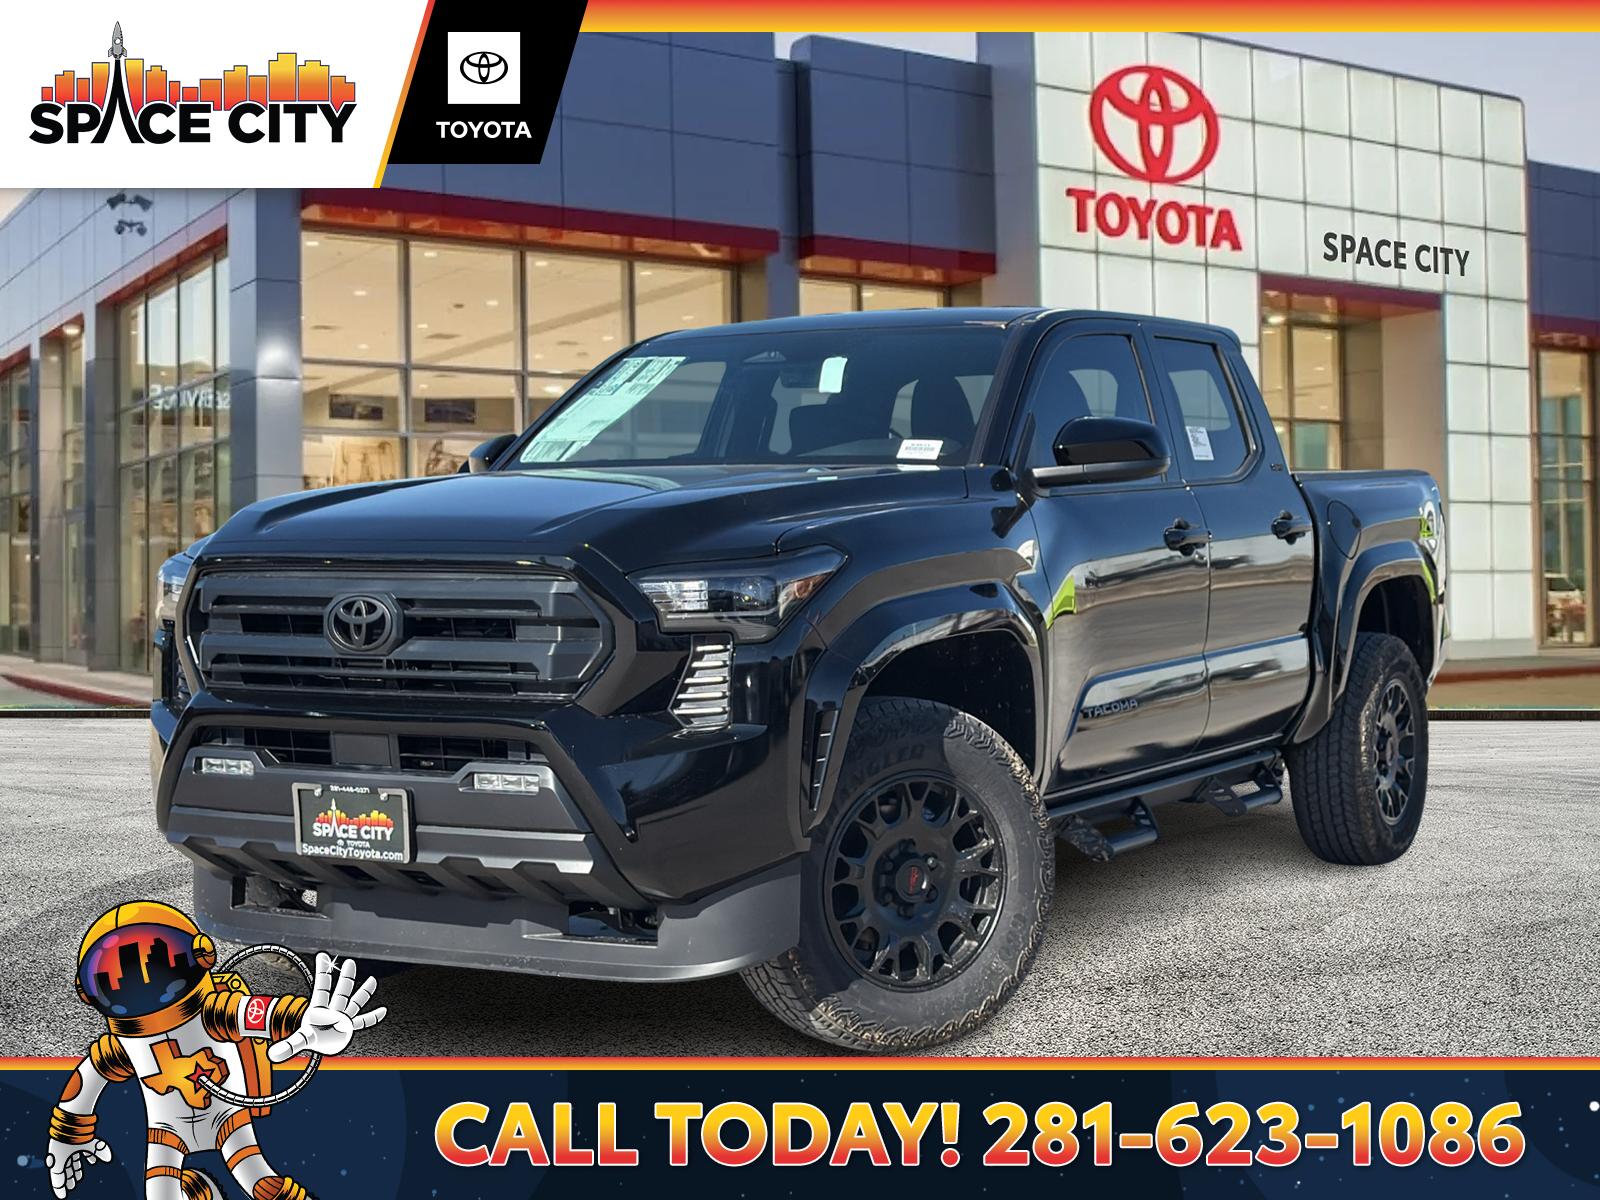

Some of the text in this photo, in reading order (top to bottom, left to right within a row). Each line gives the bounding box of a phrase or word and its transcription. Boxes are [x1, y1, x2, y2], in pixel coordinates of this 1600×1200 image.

[1066, 187, 1242, 251] TOYOTA
[1323, 231, 1470, 277] SPACE CITY
[1084, 698, 1138, 718] TACOMA
[312, 820, 394, 841] SPACE CITY
[302, 843, 403, 860] SpaceCityToyota.com
[346, 840, 371, 849] TOYOTA
